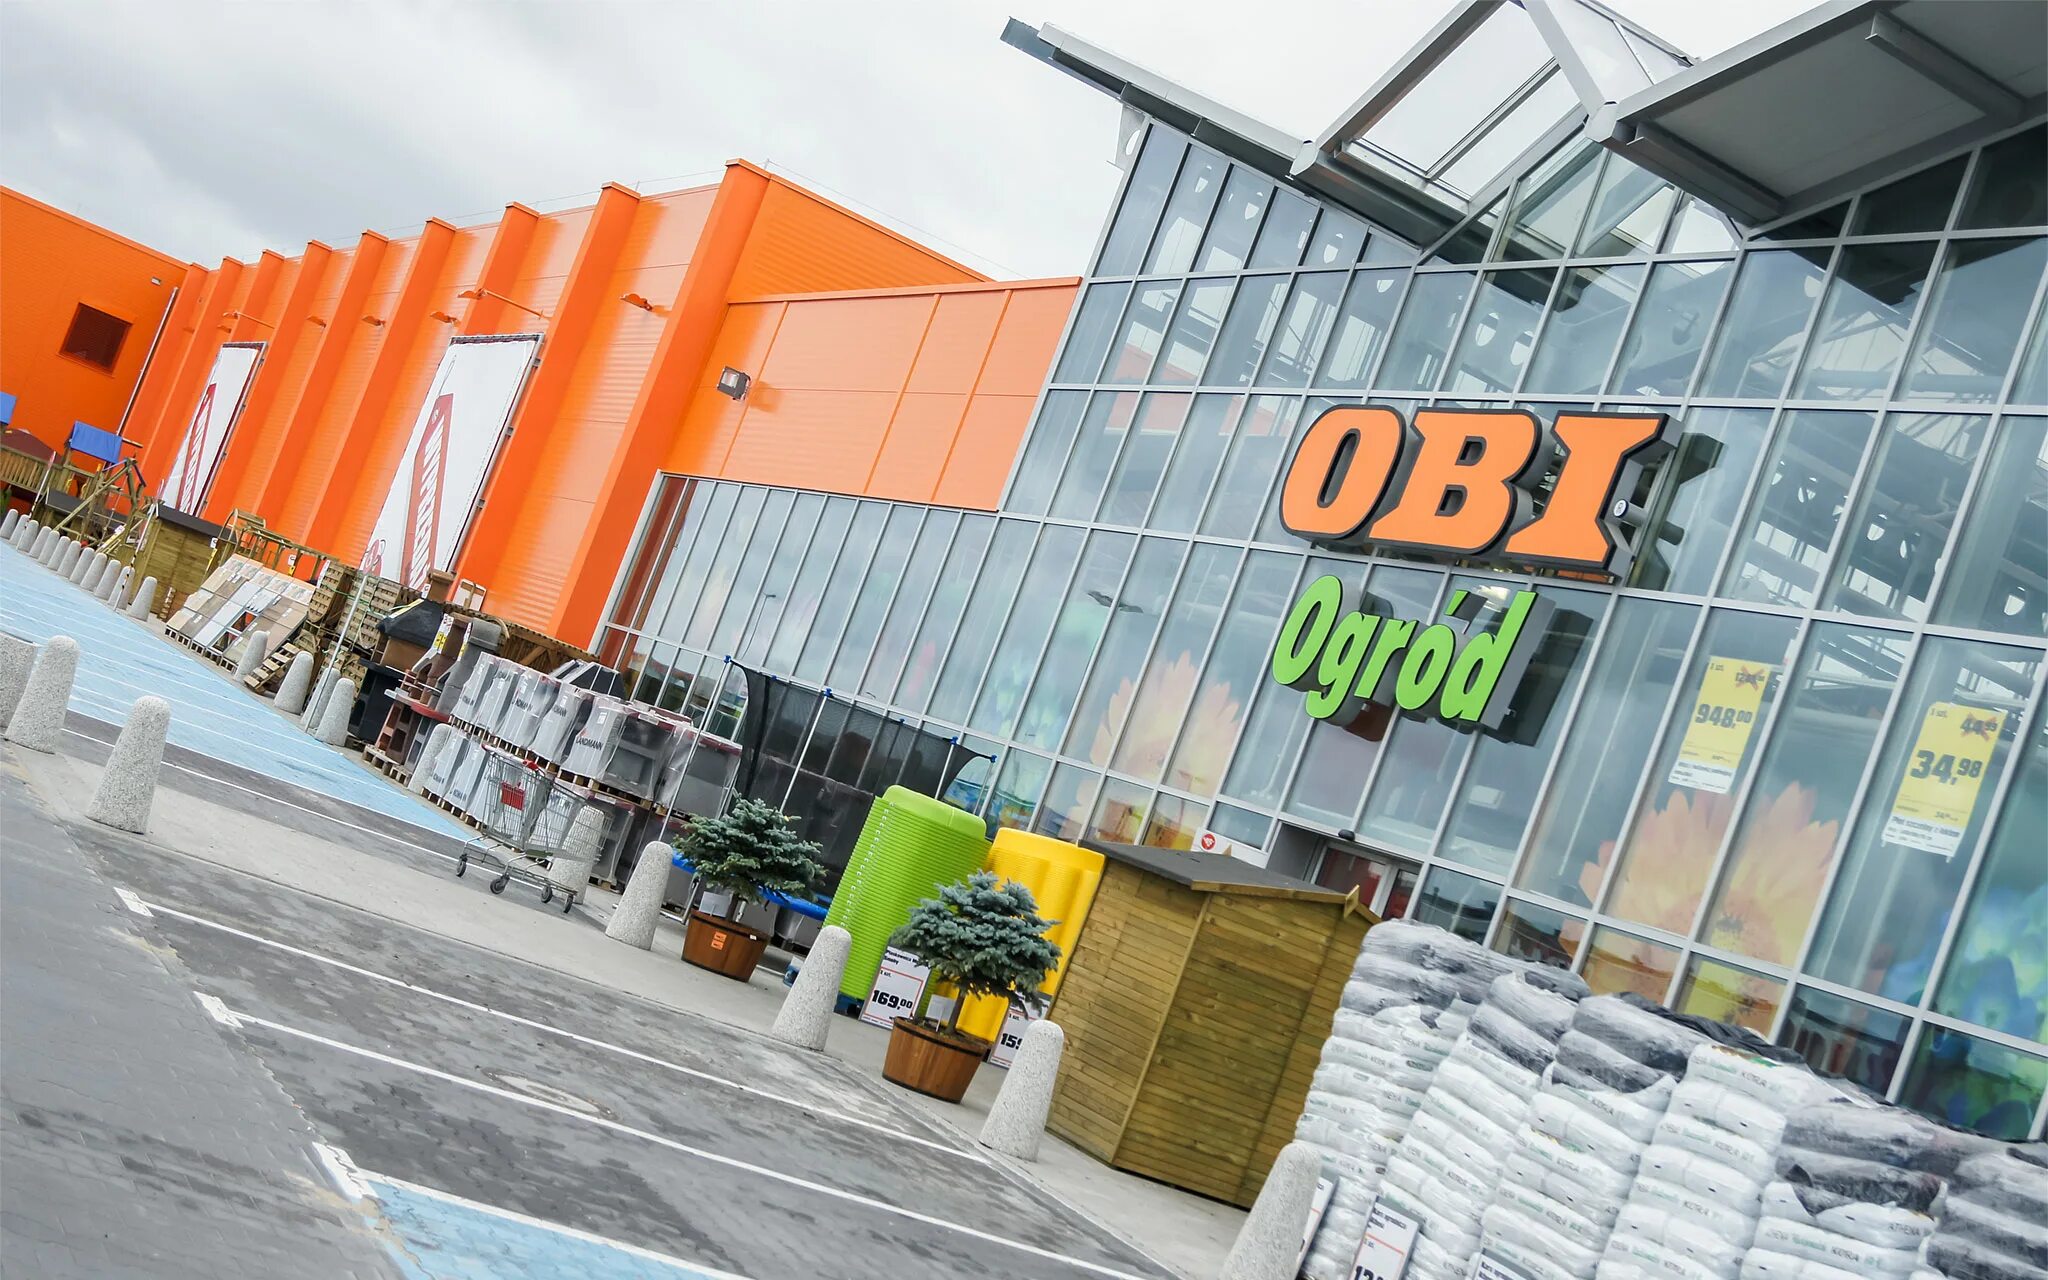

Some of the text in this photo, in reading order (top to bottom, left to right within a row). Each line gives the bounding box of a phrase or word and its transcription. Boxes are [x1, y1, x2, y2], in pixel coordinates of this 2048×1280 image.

[1279, 404, 1669, 568] OBI
[1272, 575, 1538, 722] Ogród
[1695, 703, 1753, 729] 948,00
[575, 736, 603, 751] LANDMANN
[1910, 749, 1982, 785] 34,98
[872, 989, 913, 1010] 169,00
